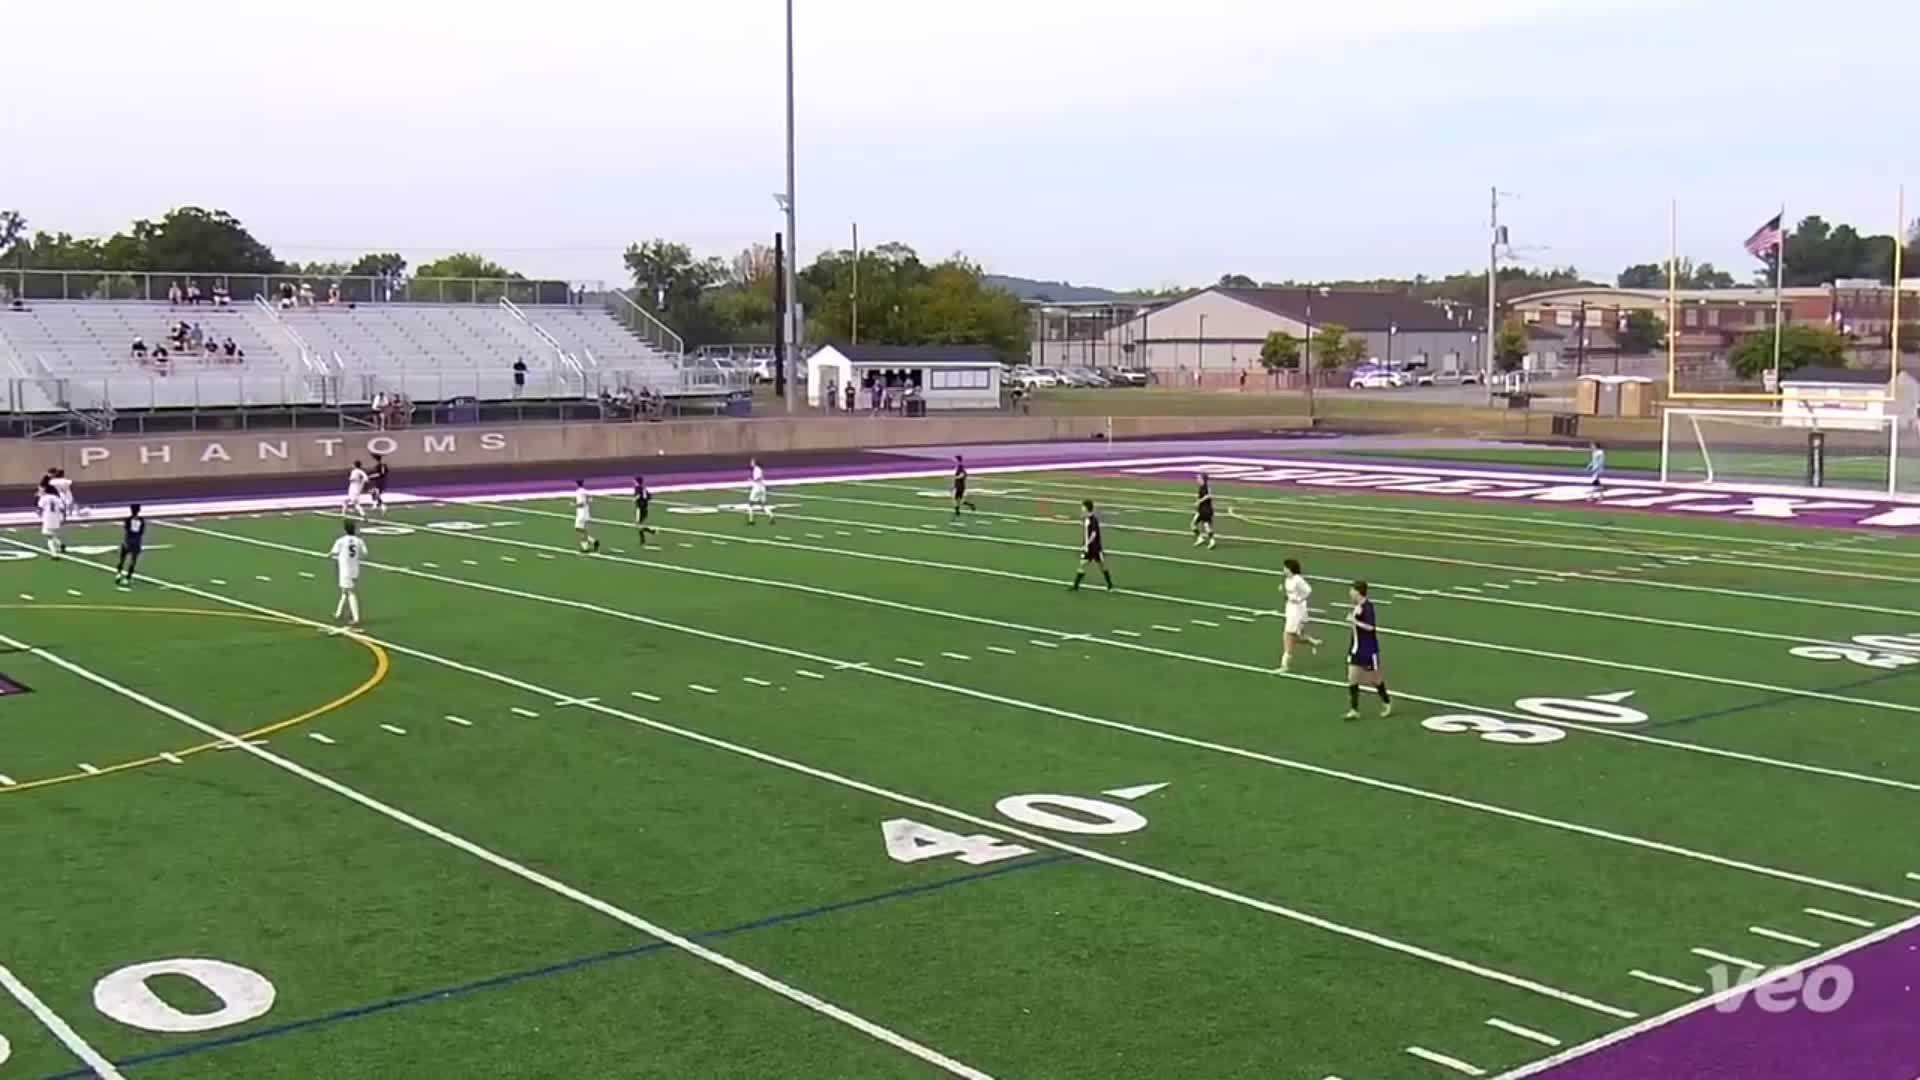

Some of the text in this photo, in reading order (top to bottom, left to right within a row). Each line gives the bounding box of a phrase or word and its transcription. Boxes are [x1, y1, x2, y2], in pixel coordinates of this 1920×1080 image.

[80, 433, 506, 466] PHANTOMS
[1421, 697, 1649, 744] 30
[881, 794, 1148, 865] 40
